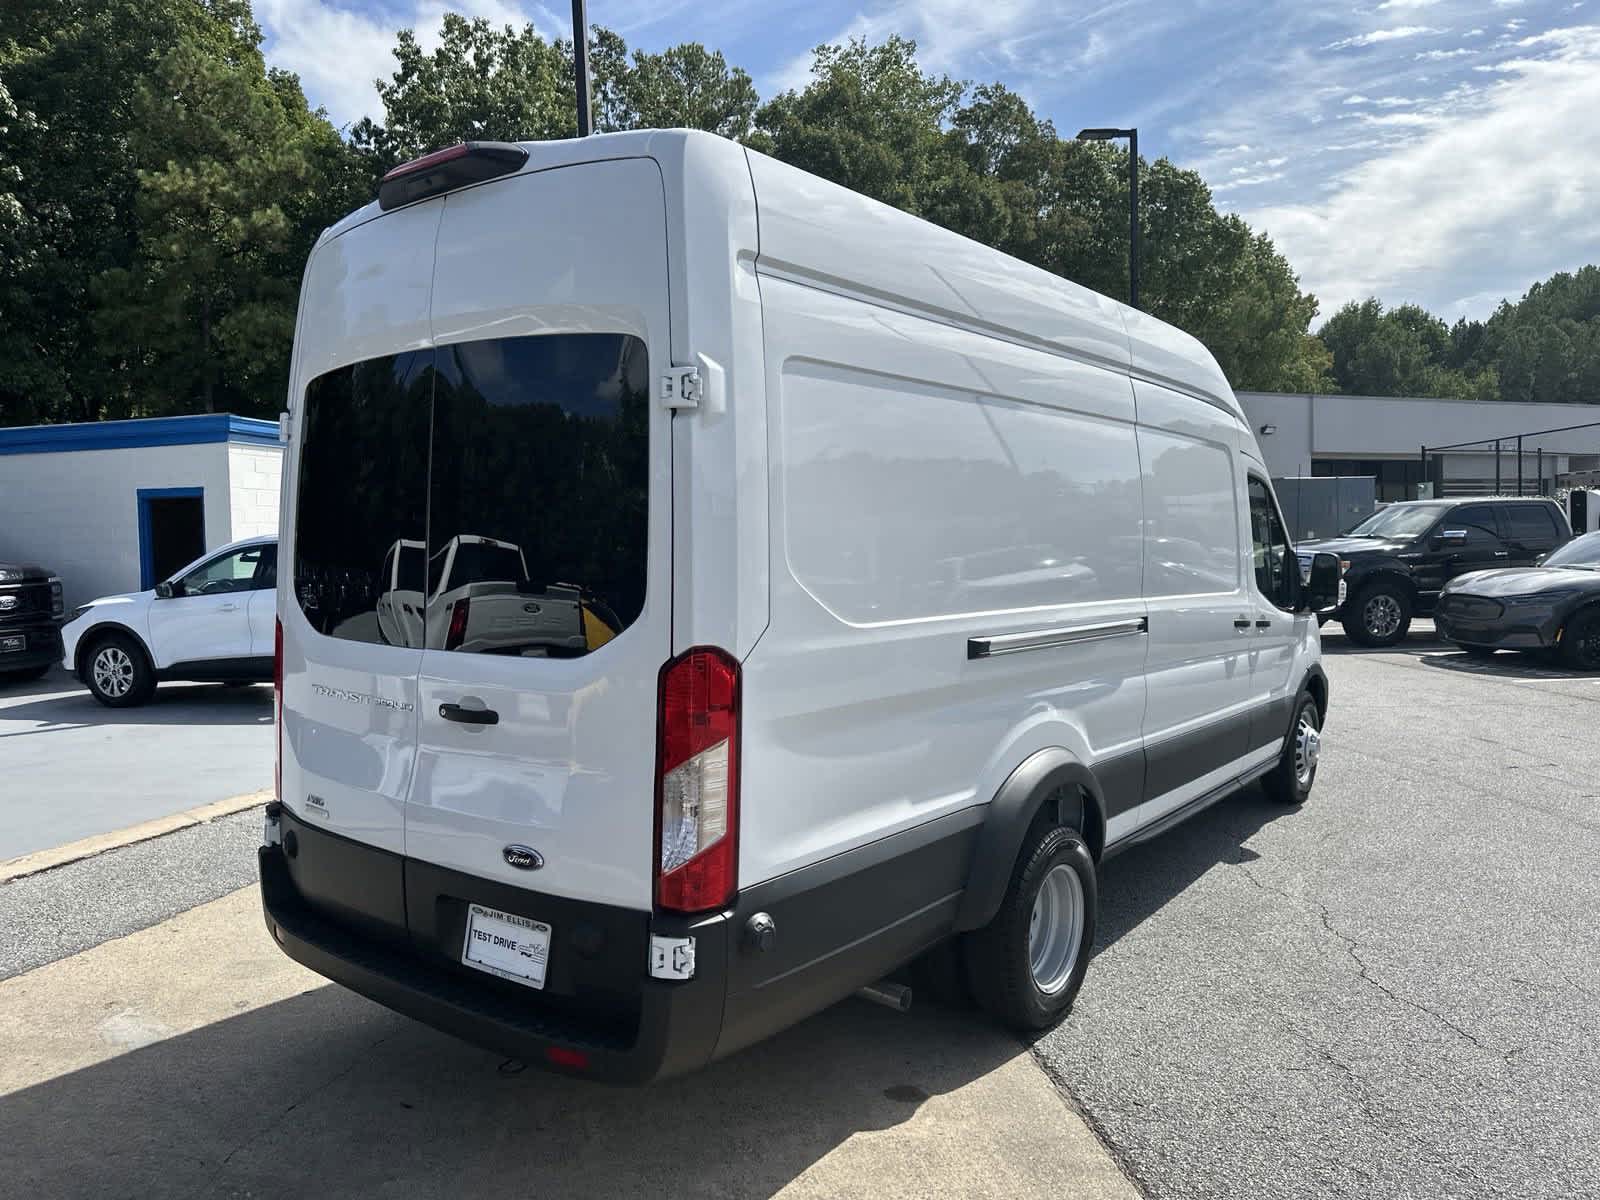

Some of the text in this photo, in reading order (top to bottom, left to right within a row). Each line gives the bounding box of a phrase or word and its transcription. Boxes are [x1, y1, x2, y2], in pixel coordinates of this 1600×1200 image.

[311, 683, 371, 704] TRANSIT
[507, 854, 531, 865] Ford
[489, 911, 504, 921] JIM
[506, 915, 531, 928] ELLIS
[472, 928, 492, 944] TEST
[493, 935, 517, 951] DRIVE
